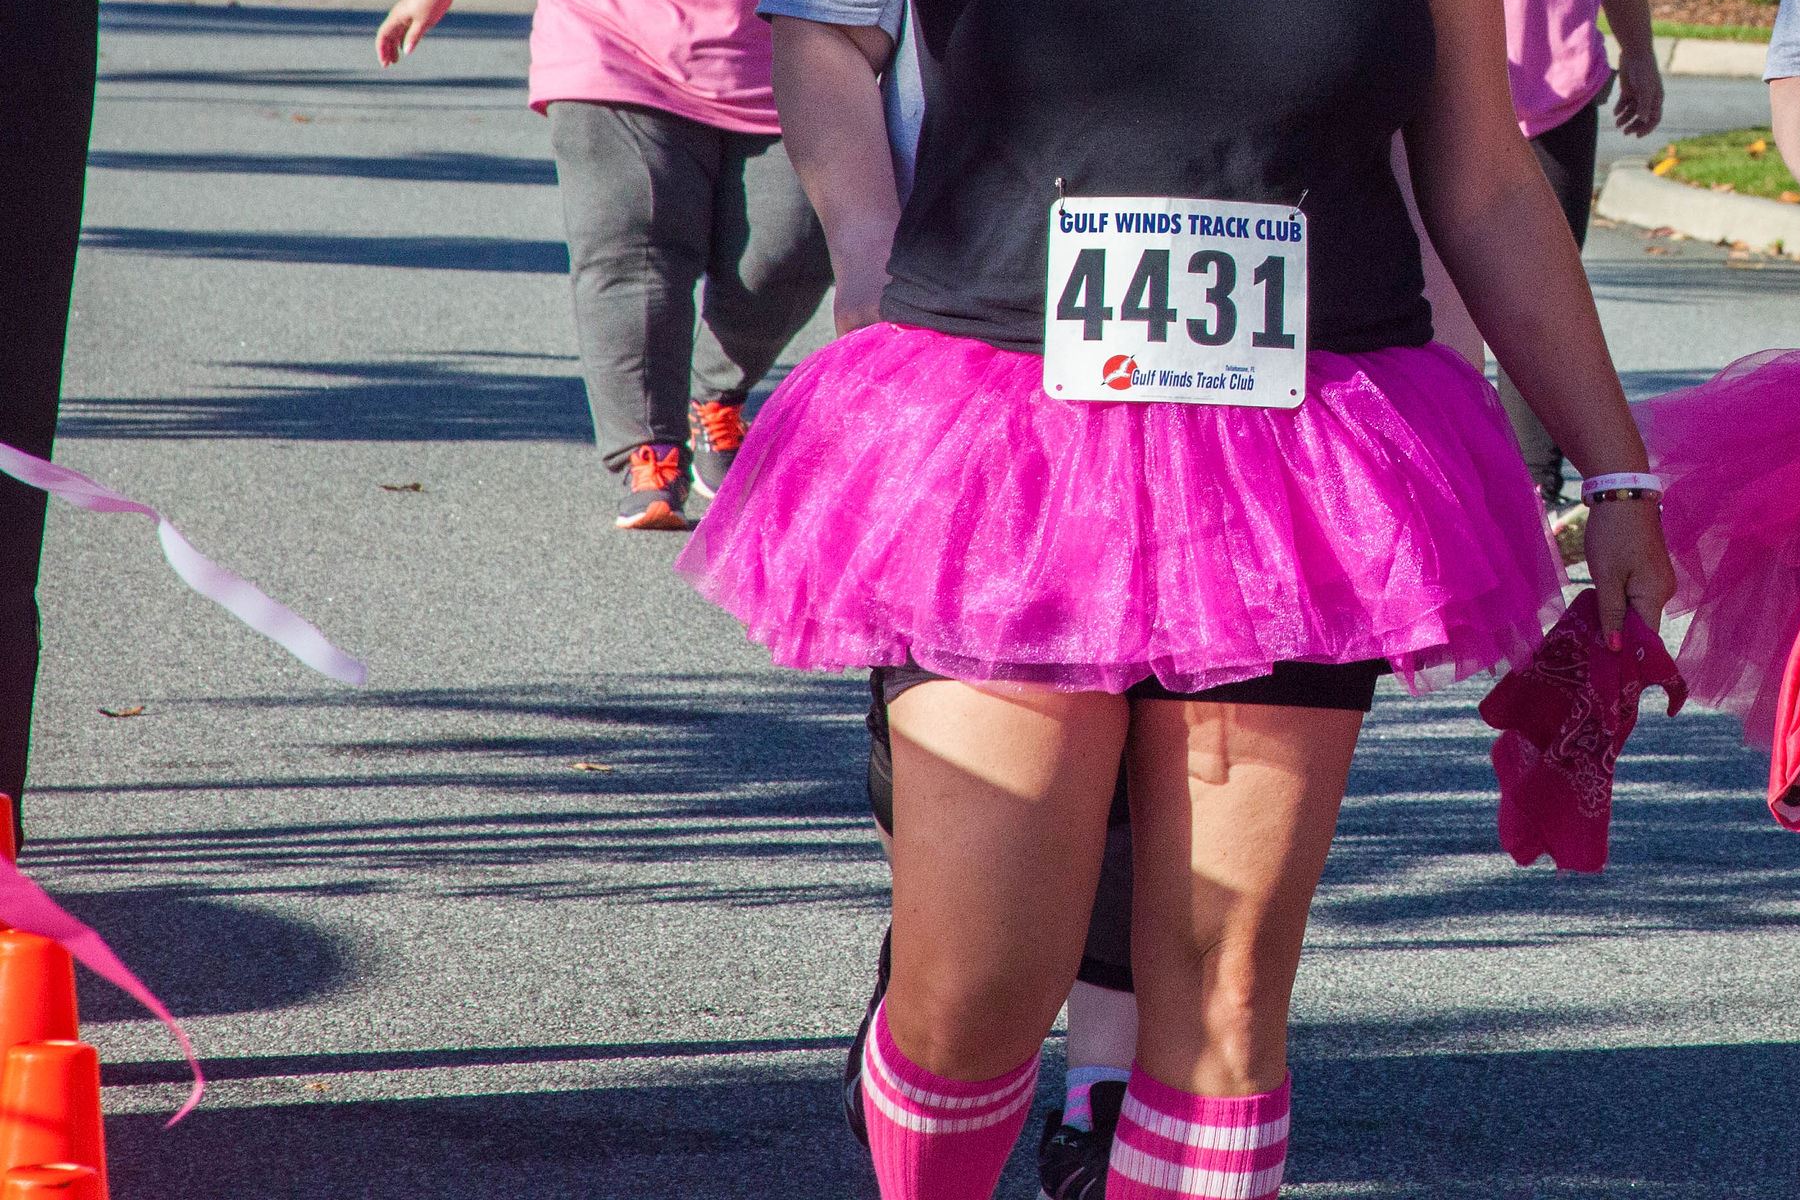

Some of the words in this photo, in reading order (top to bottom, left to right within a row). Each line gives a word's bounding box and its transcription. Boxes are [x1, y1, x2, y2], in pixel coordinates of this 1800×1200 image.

[1060, 212, 1109, 234] GULF
[1115, 213, 1182, 235] WINDS
[1188, 214, 1250, 239] TRACK
[1255, 219, 1302, 242] CLUB
[1056, 248, 1296, 349] 4431
[1132, 369, 1155, 386] Gulf
[1159, 370, 1192, 388] Winds
[1197, 371, 1227, 390] Track
[1229, 373, 1255, 391] Club
